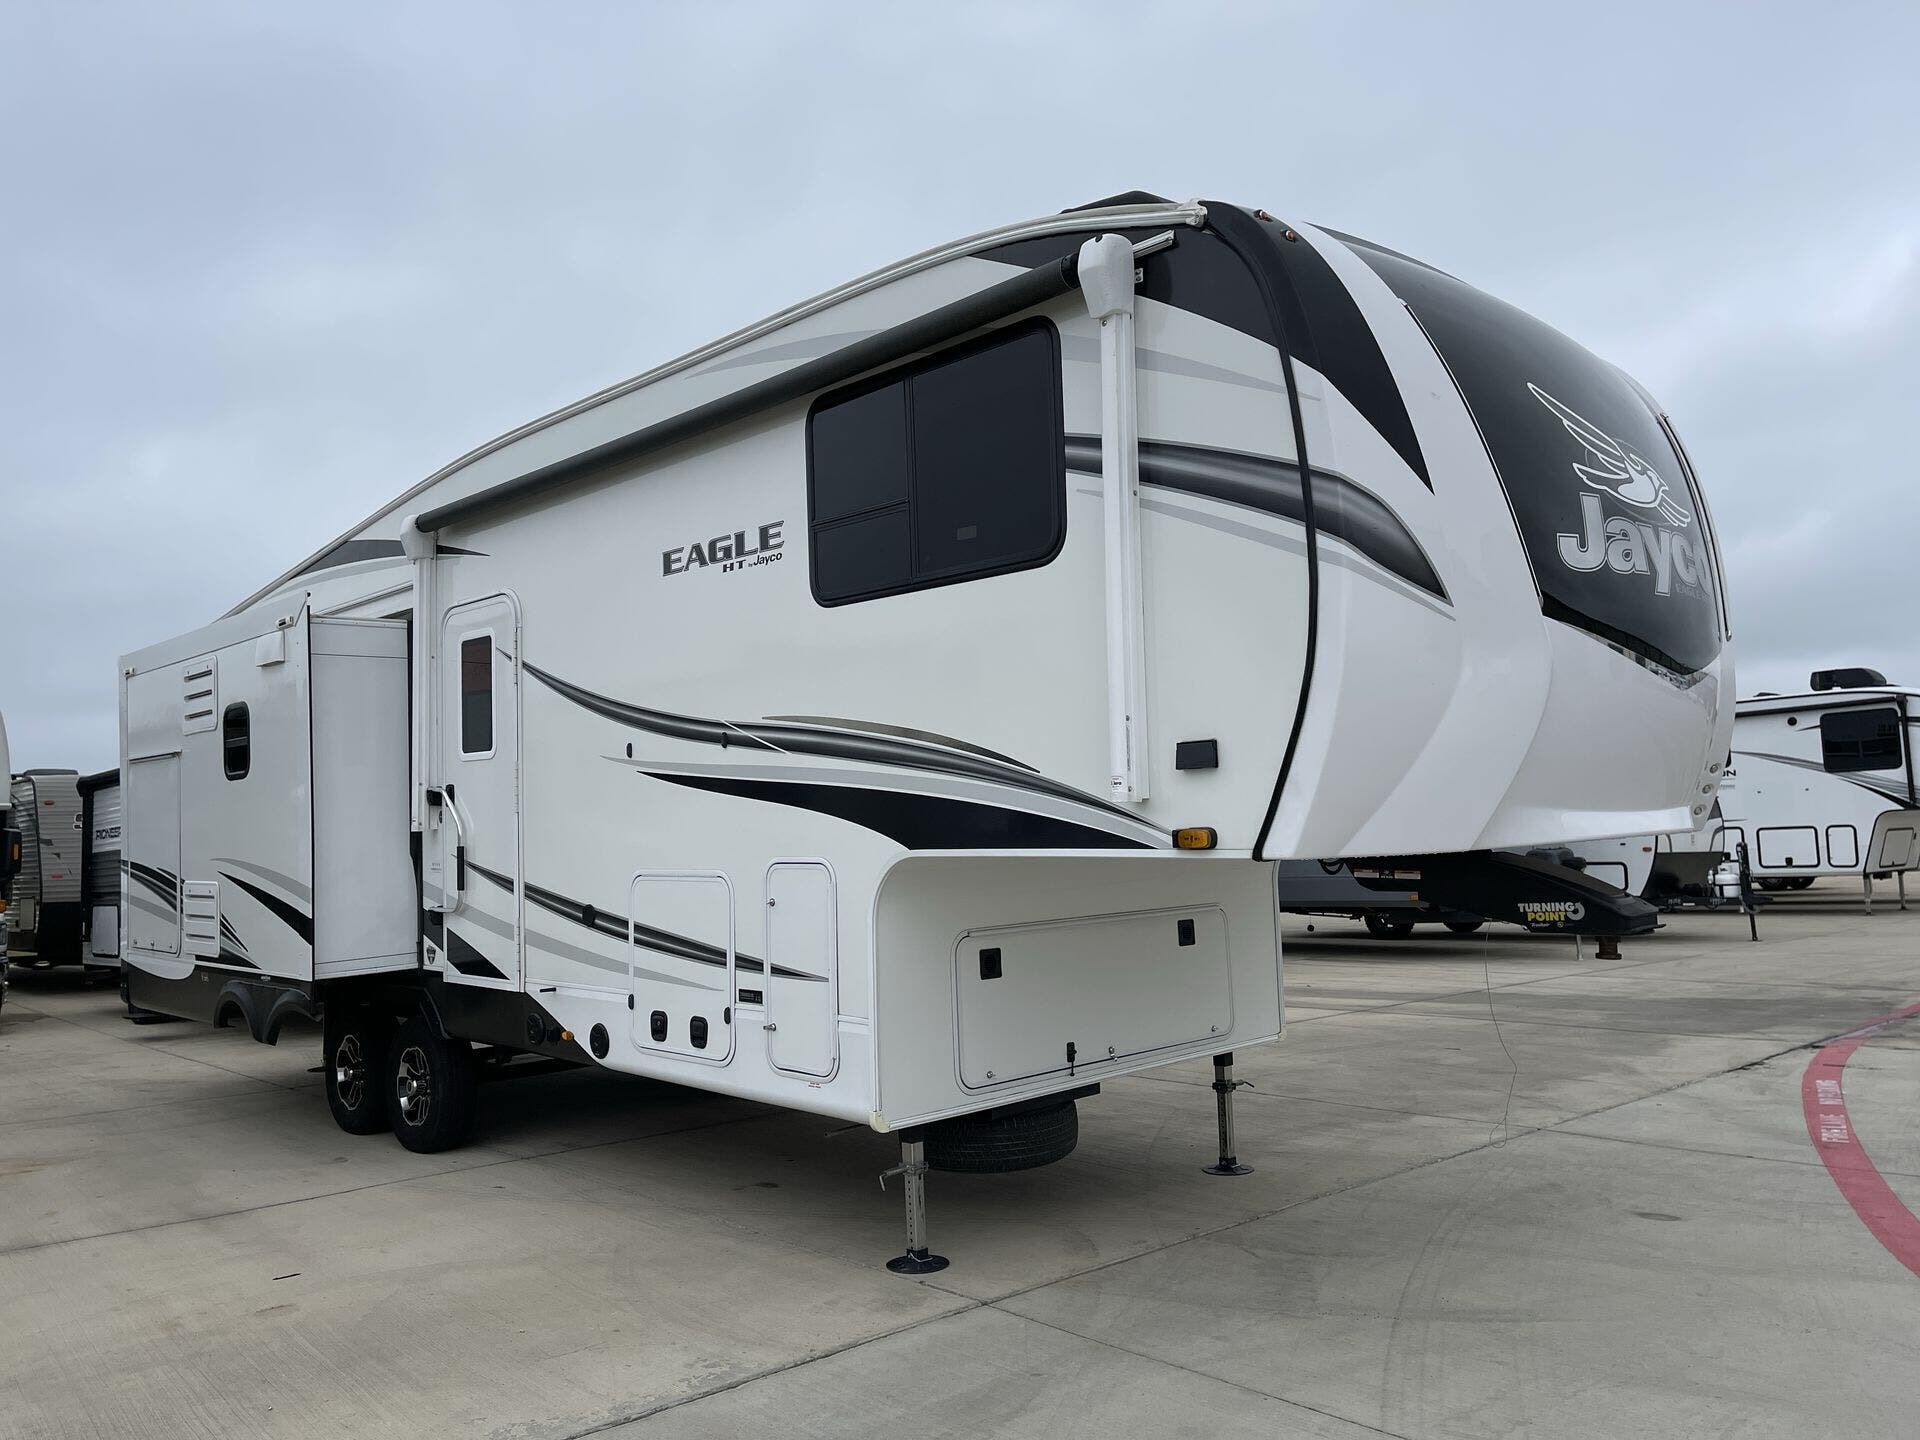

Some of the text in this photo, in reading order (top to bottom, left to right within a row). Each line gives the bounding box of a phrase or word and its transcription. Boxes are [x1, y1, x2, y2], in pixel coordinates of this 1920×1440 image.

[662, 520, 785, 577] EAGLE
[722, 559, 747, 573] HT
[753, 552, 783, 566] Jayco
[1517, 902, 1575, 912] TURNING
[1527, 911, 1566, 921] POINT
